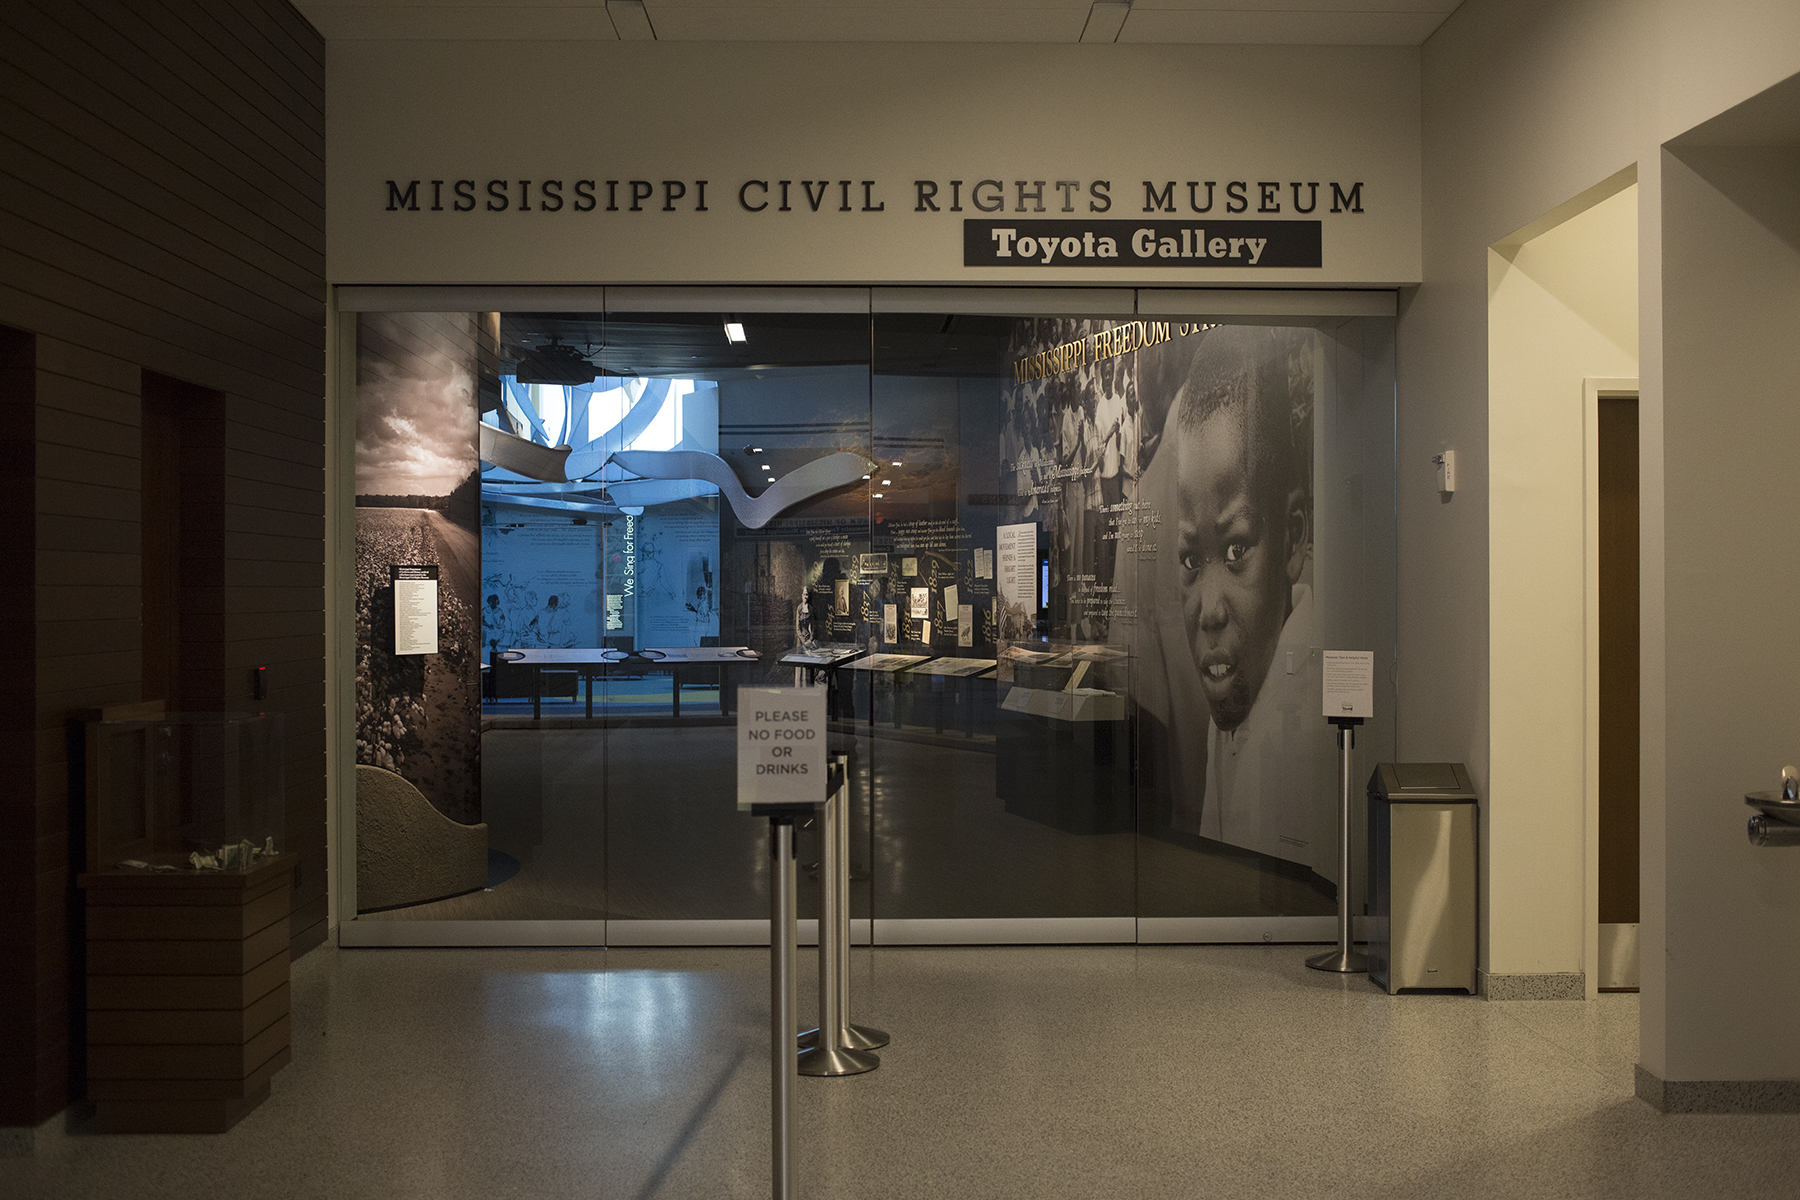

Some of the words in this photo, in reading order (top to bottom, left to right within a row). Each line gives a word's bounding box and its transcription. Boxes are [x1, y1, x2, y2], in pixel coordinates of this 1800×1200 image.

[386, 180, 708, 212] MISSISSIPPI
[738, 180, 883, 212] CIVIL
[914, 180, 1111, 212] RIGHTS
[1143, 181, 1364, 213] MUSEUM
[991, 228, 1118, 264] Toyota
[1131, 228, 1268, 264] Gallery
[1013, 337, 1087, 387] MISSISSIPPI
[1093, 320, 1172, 363] FREEDOM
[1110, 498, 1133, 516] something
[622, 541, 634, 554] for
[623, 555, 636, 576] Sing
[850, 554, 859, 585] 1839
[888, 561, 900, 594] 1834
[928, 559, 939, 594] 1829
[964, 560, 973, 594] 1822
[624, 578, 634, 597] We
[825, 603, 835, 636] 1845
[861, 590, 871, 623] 1837
[934, 600, 945, 636] 1827
[902, 610, 912, 640] 1831
[981, 608, 991, 643] 1816
[755, 710, 809, 722] PLEASE
[748, 729, 770, 740] NO
[774, 729, 815, 740] FOOD
[772, 746, 792, 757] OR
[756, 763, 808, 775] DRINKS
